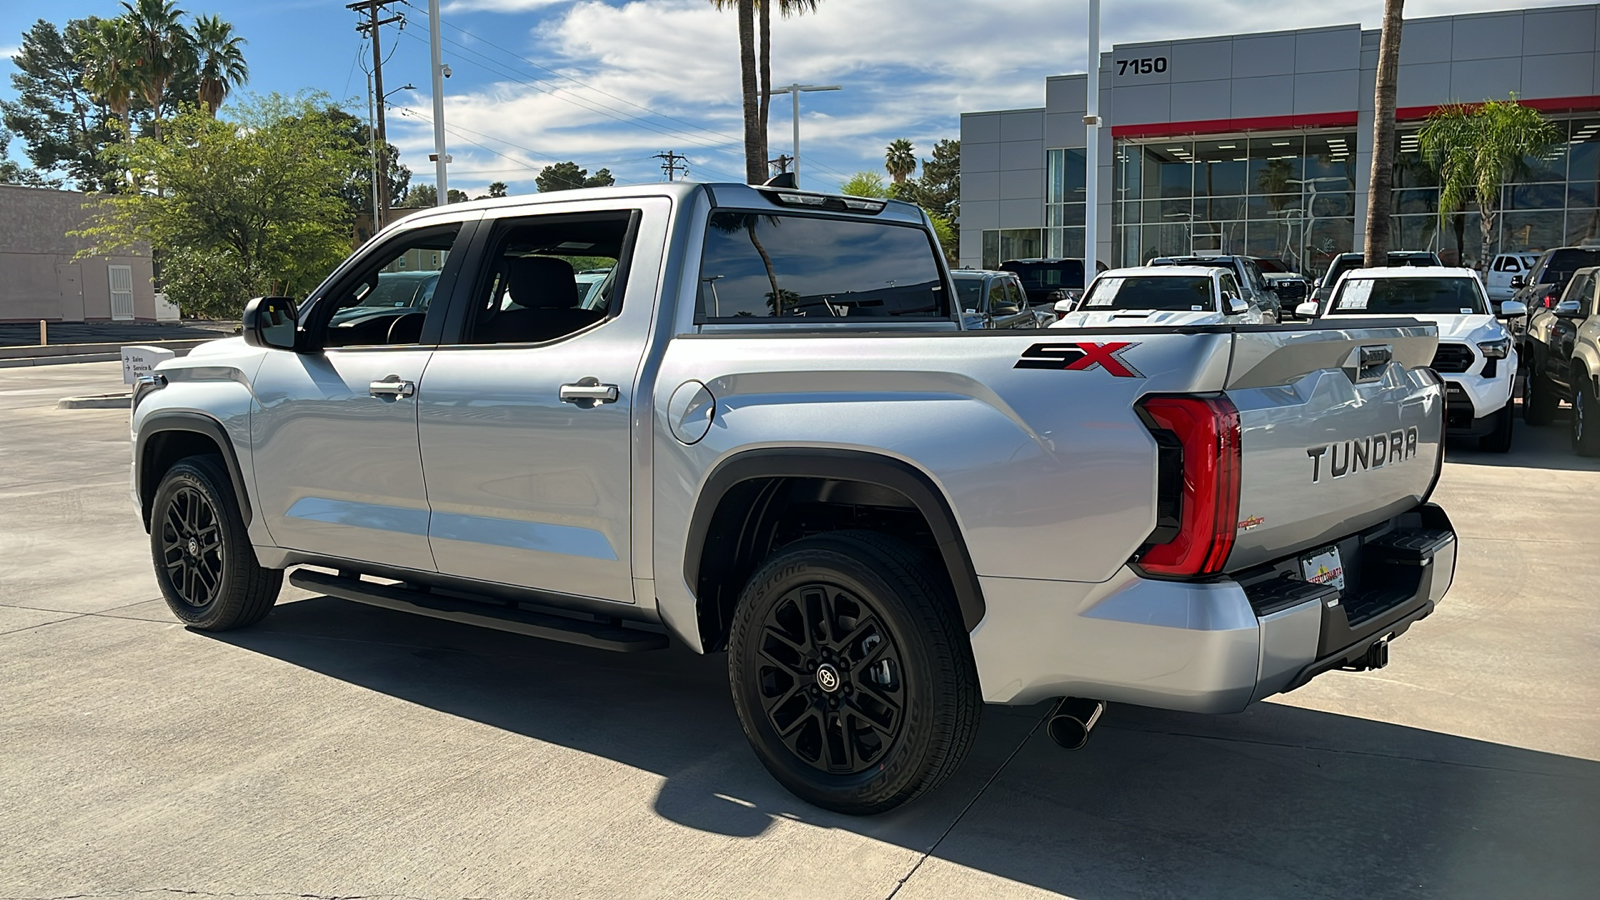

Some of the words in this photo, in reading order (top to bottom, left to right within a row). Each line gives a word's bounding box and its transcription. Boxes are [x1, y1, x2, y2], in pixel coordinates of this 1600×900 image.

[1116, 57, 1167, 76] 7150
[1306, 425, 1419, 484] TUNDRA
[735, 562, 808, 684] BRIDGESTONE
